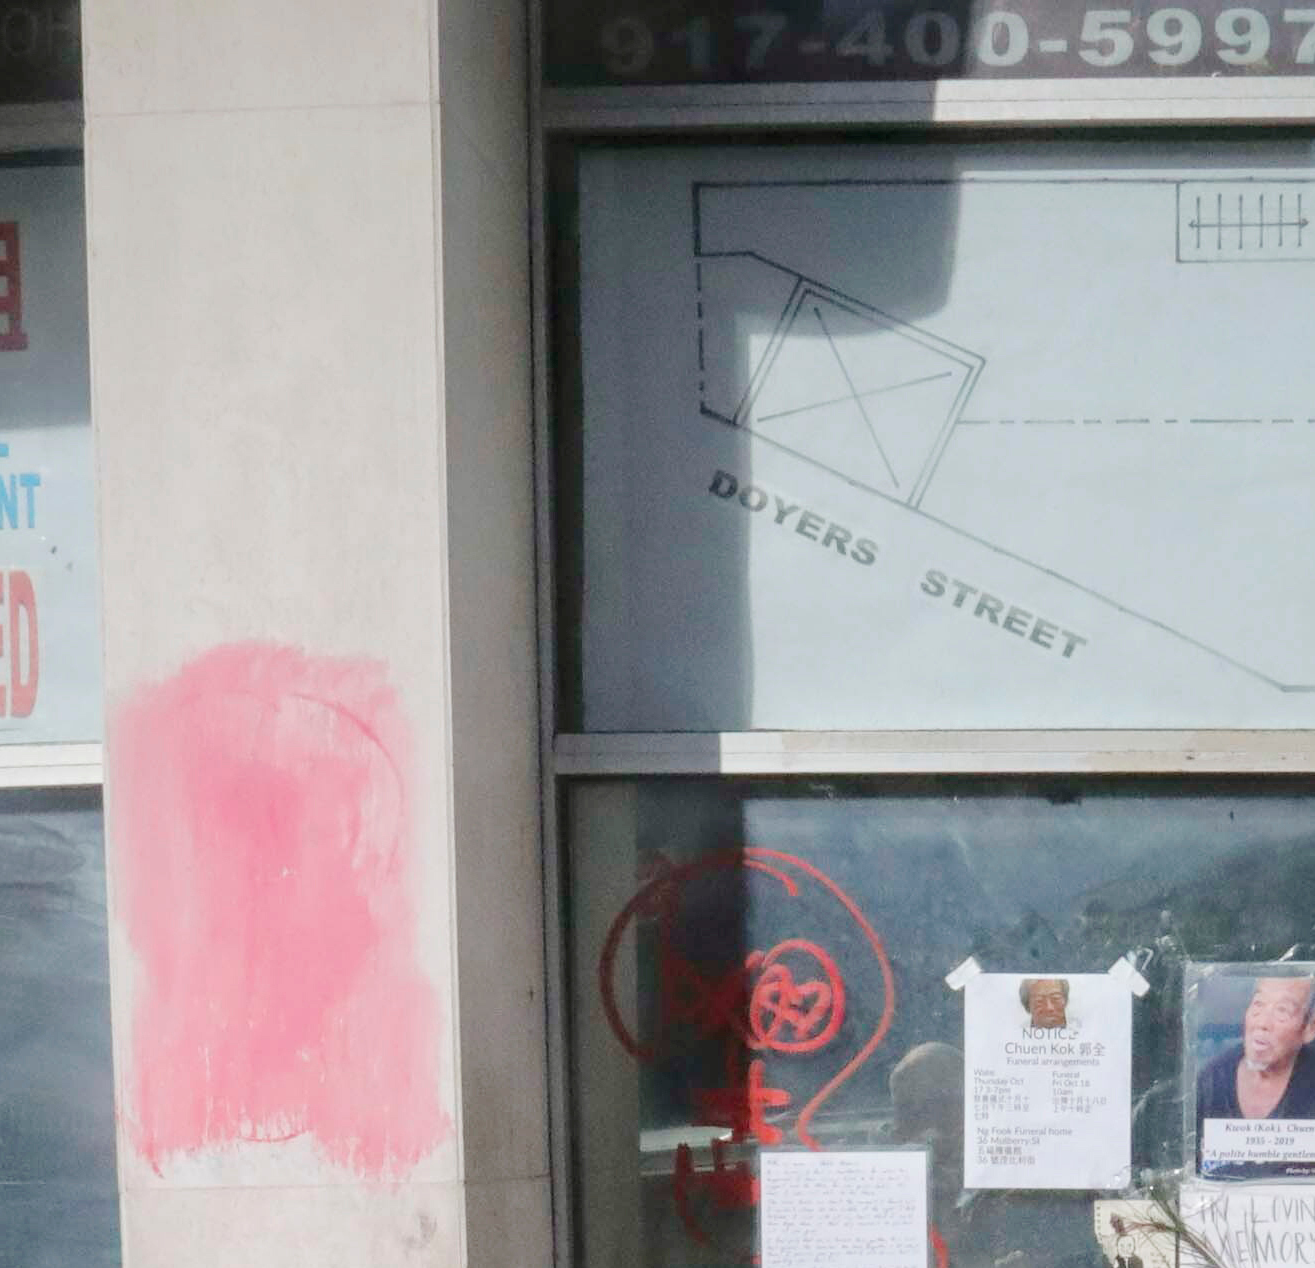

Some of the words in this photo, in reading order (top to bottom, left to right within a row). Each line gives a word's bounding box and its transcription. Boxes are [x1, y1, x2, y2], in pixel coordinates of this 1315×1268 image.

[707, 469, 880, 567] DOYERS
[919, 568, 1088, 660] STREET
[1004, 1041, 1047, 1056] Chuen
[1050, 1041, 1076, 1056] Kok
[1006, 1056, 1039, 1067] Funeral
[1041, 1057, 1101, 1069] arrangements
[991, 1126, 1012, 1136] Fook
[1014, 1126, 1047, 1136] Funeral
[1048, 1126, 1073, 1136] home
[1286, 1123, 1315, 1133] Chuen
[1274, 1136, 1296, 1146] 2019
[1219, 1149, 1246, 1161] polite
[1247, 1149, 1282, 1159] humble
[1199, 1195, 1230, 1224] IN
